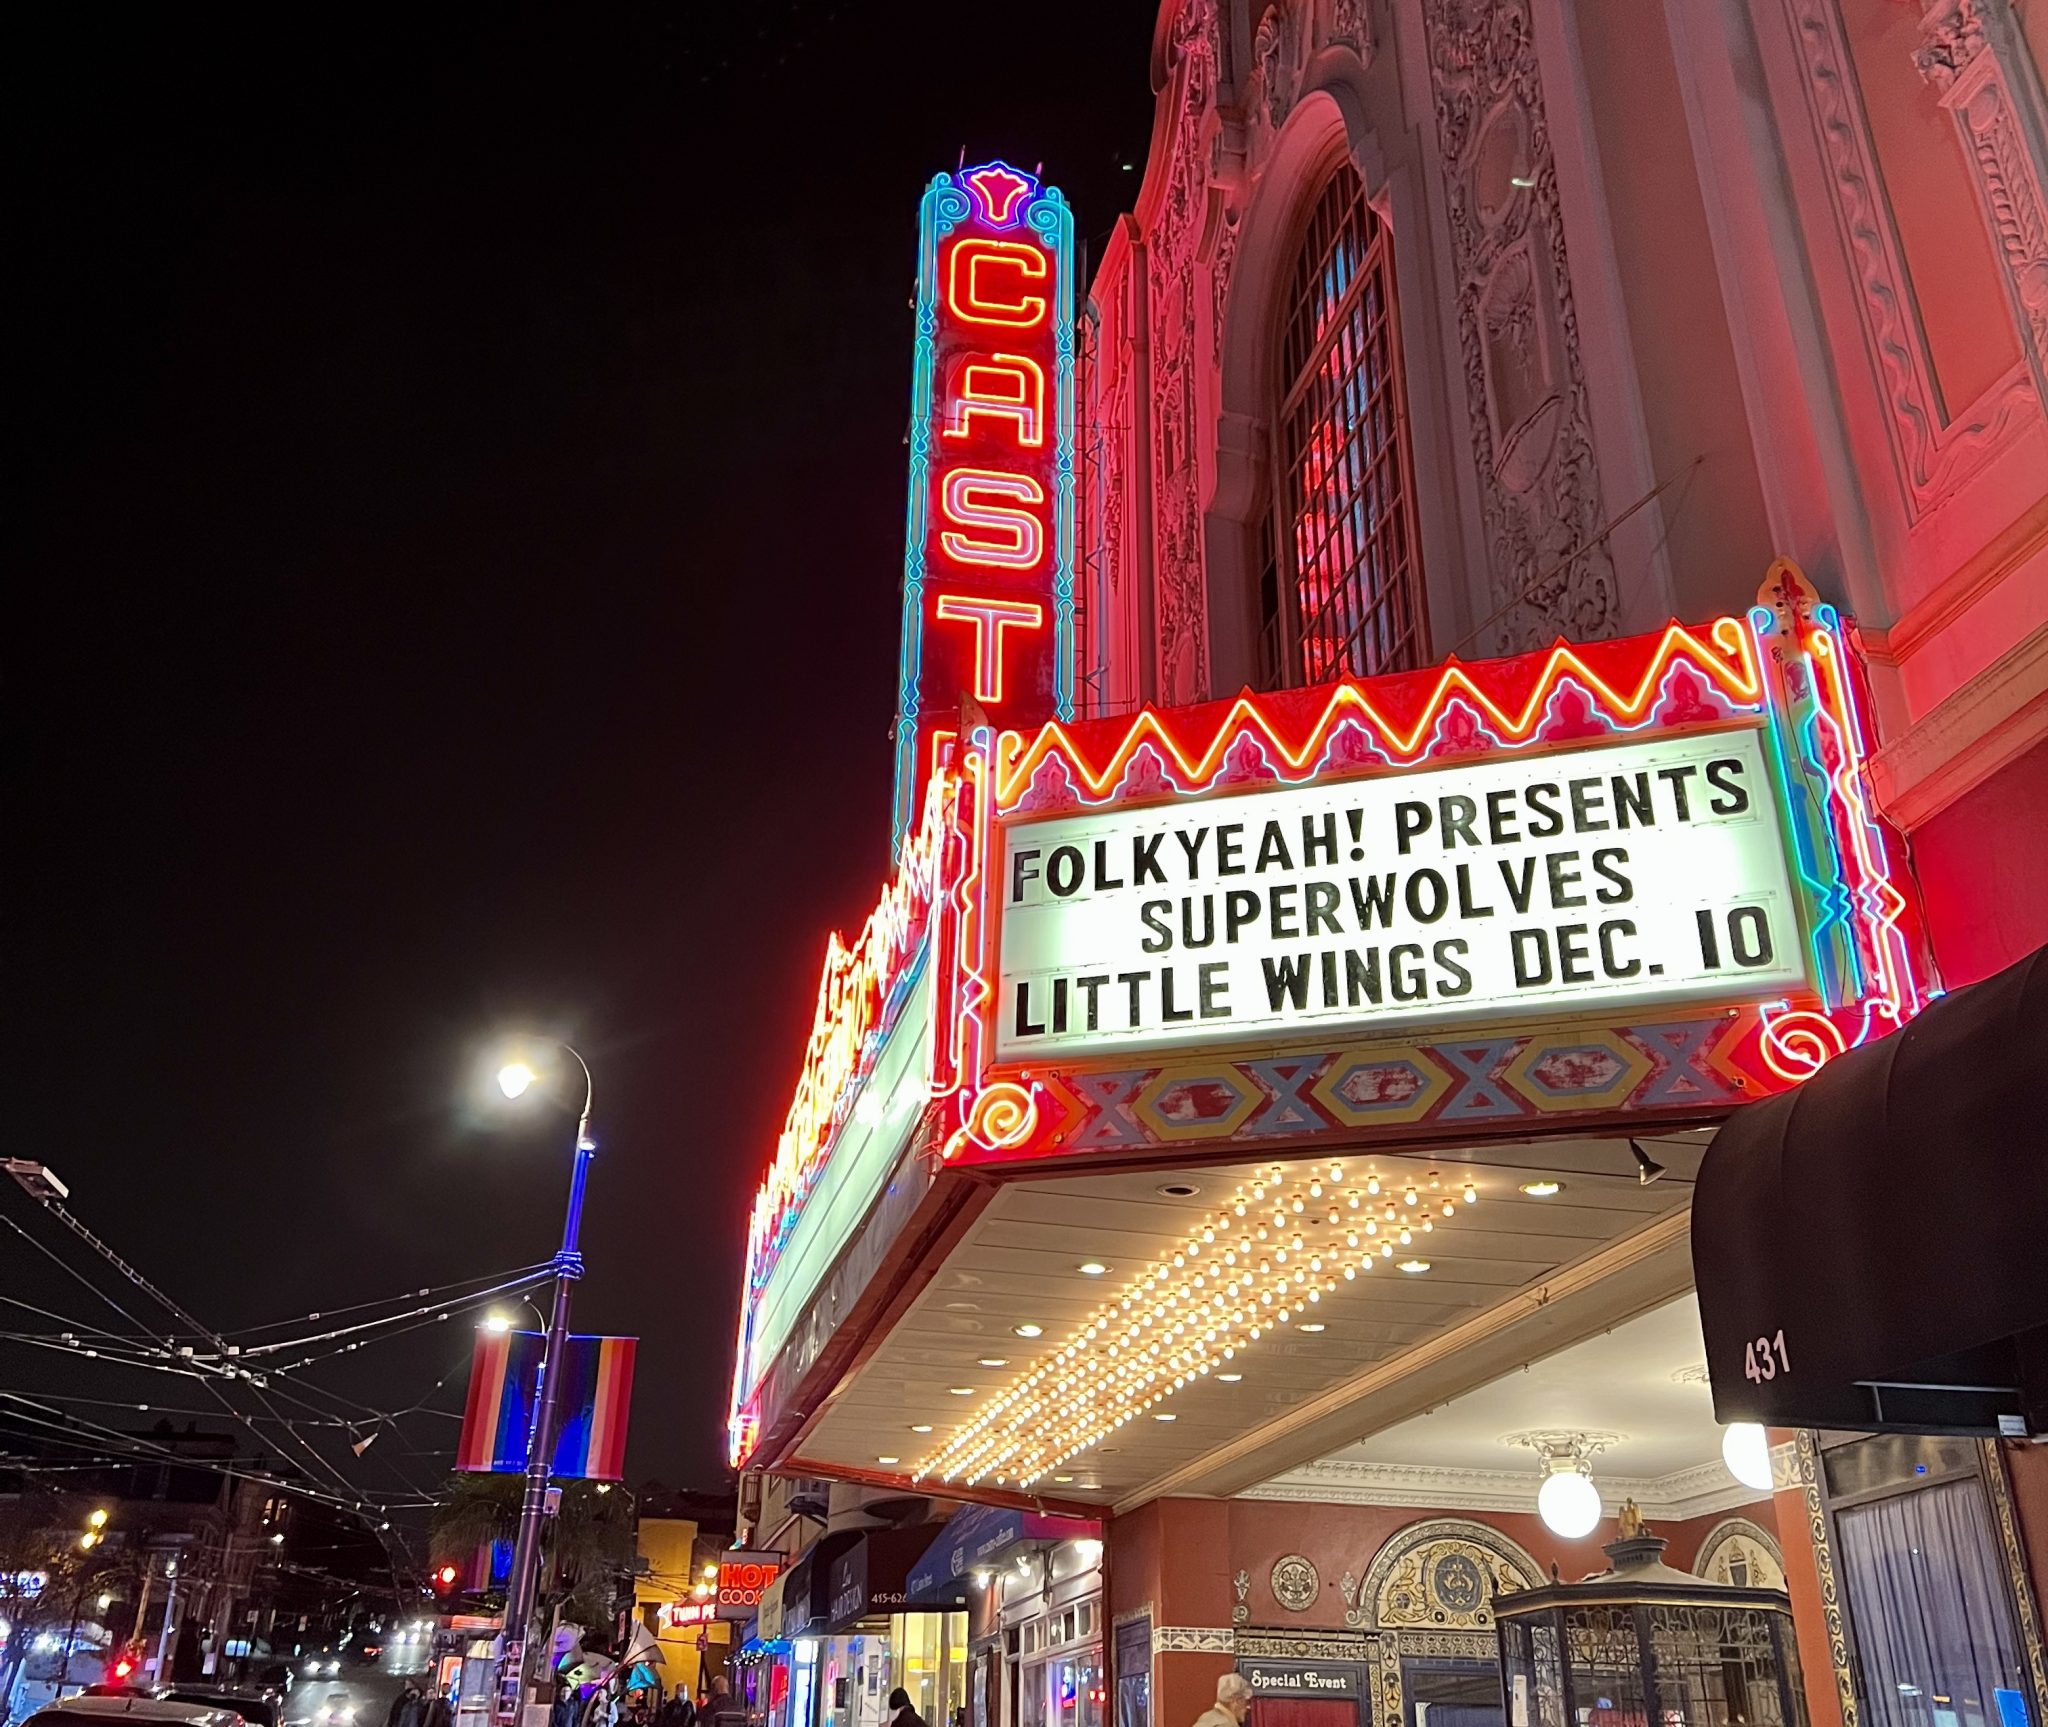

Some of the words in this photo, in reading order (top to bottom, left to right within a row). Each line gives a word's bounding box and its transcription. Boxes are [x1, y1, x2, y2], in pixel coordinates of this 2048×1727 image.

[1012, 808, 1365, 903] FOLKYEAH!
[1395, 758, 1750, 855] PRESENTS
[1140, 847, 1634, 954] SUPERWOLVES
[1015, 961, 1233, 1037] LITTLE
[1260, 938, 1473, 1013] WINGS
[1510, 919, 1665, 989] DEC.
[1695, 906, 1774, 970] 10
[1745, 1329, 1791, 1385] 431
[720, 1563, 779, 1589] HOT
[673, 1605, 701, 1621] TWIN
[1251, 1669, 1301, 1689] Special
[1304, 1671, 1347, 1689] Event
